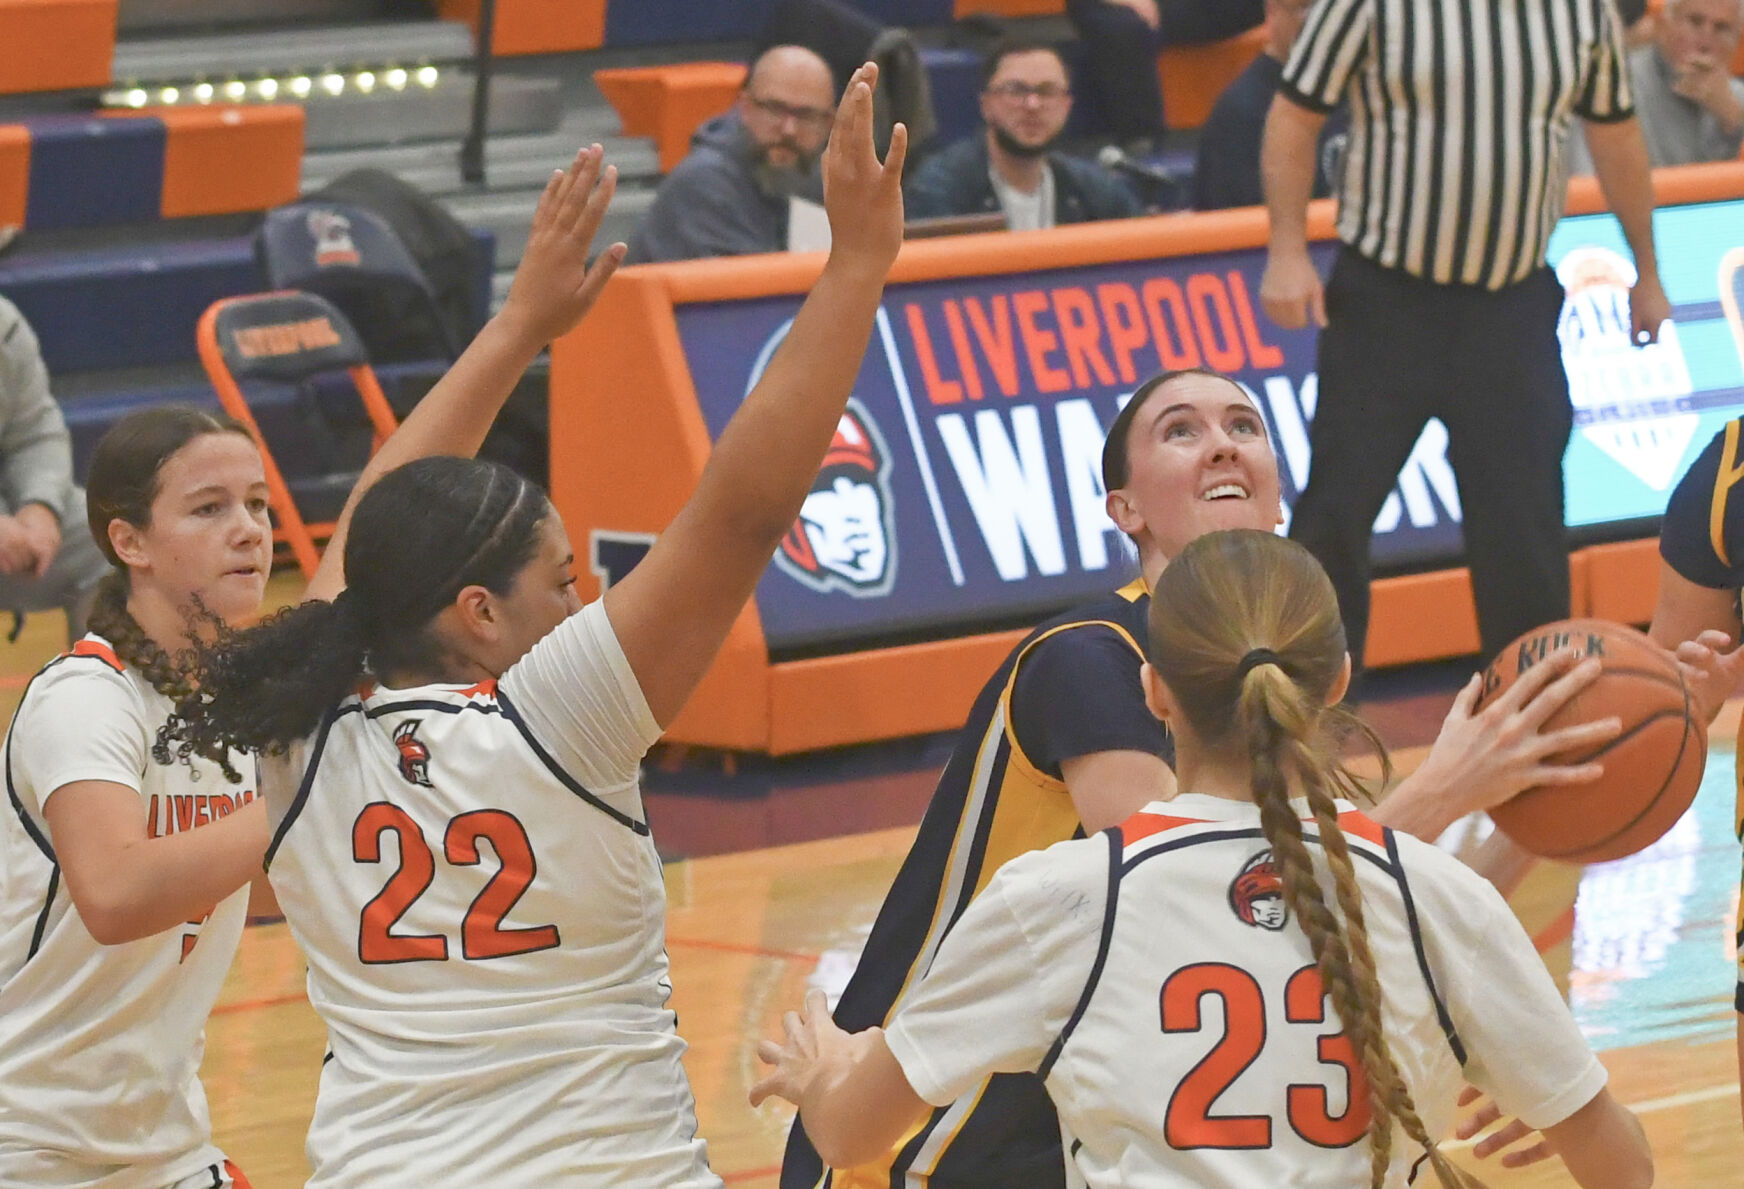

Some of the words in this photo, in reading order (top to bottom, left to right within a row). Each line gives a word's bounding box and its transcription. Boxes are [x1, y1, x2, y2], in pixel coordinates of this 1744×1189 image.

[905, 270, 1284, 405] LIVERPOOL
[352, 801, 561, 964] 22
[1159, 962, 1373, 1151] 23
